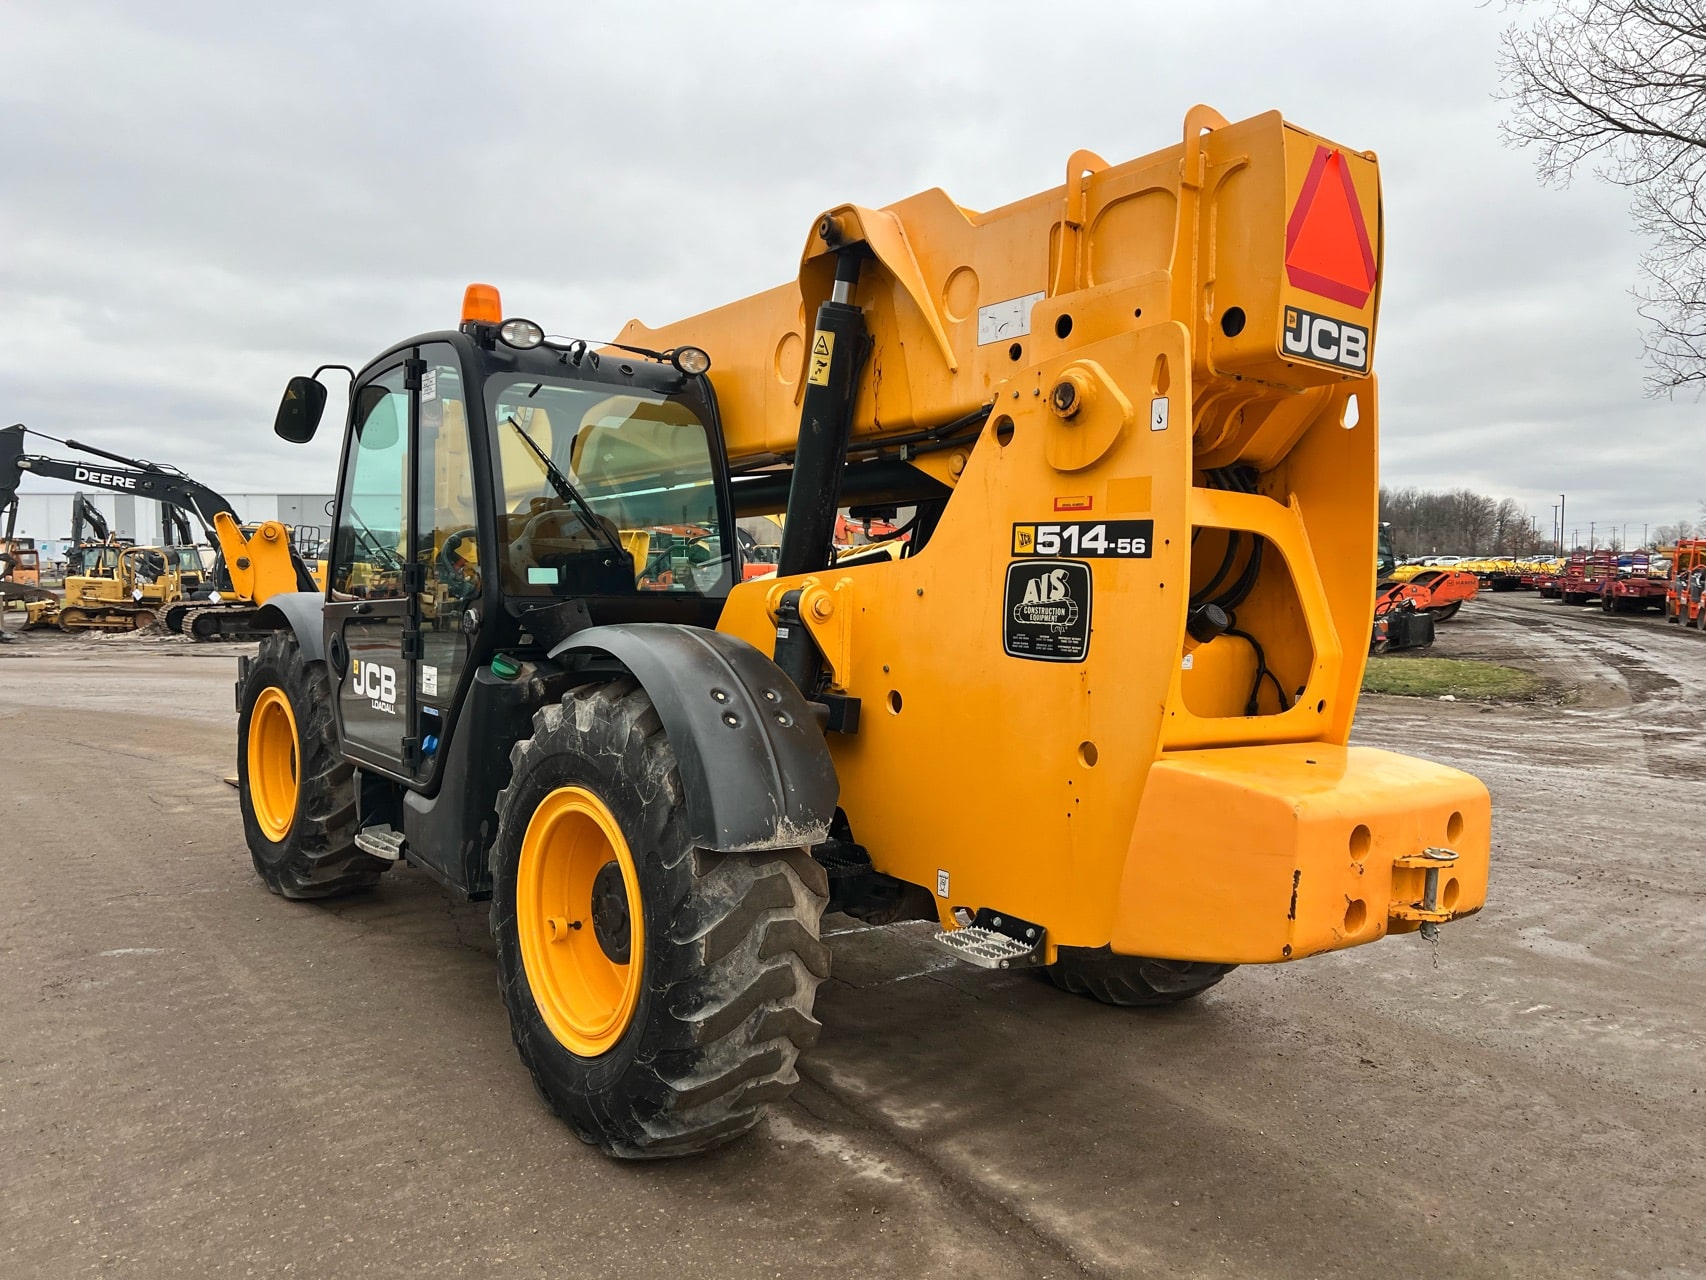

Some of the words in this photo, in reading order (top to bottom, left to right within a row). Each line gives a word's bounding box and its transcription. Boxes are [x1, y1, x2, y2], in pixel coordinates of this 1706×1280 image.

[1285, 313, 1366, 367] JCB
[75, 467, 136, 489] DEERE
[1023, 568, 1071, 604] AIS
[1023, 606, 1066, 616] CONSTRUCTION
[1029, 614, 1058, 622] EQUIPMENT
[353, 661, 396, 704] JCB
[371, 699, 396, 715] LOADALL
